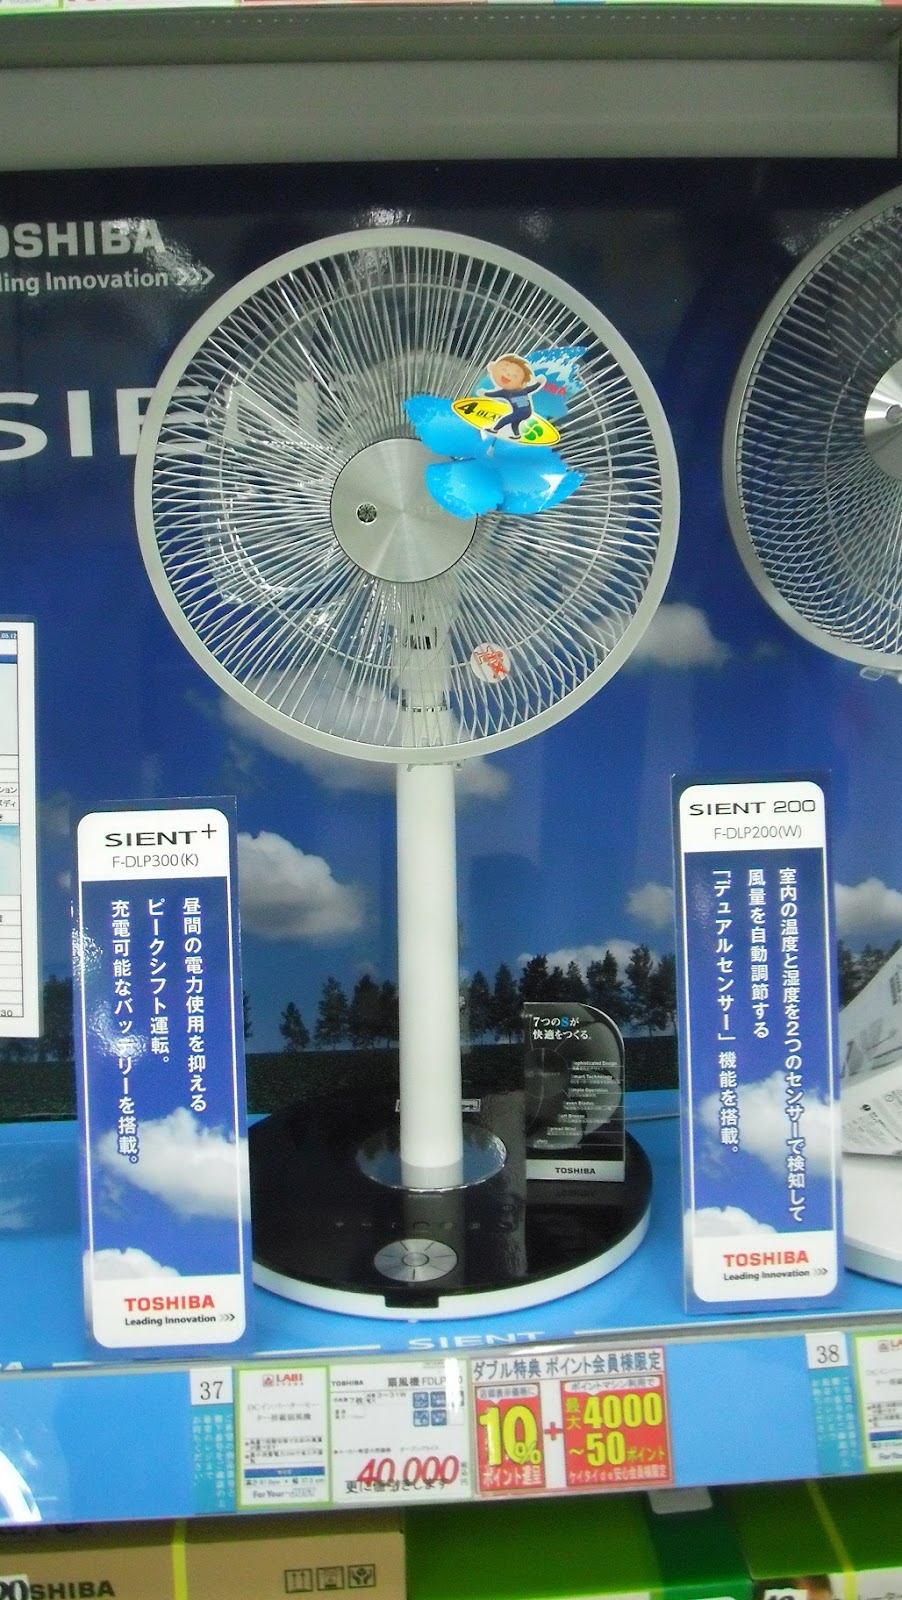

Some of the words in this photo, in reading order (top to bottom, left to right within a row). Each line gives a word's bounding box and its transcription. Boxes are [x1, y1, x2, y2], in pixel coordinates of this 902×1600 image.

[0, 218, 165, 260] SHIBA
[0, 274, 39, 297] ing
[46, 268, 169, 292] Innovation
[457, 401, 479, 415] 4
[689, 800, 767, 817] SIENT
[773, 799, 816, 814] 200
[714, 824, 803, 840] F-DLP200(W)
[112, 853, 200, 869] F-DLP300(K)
[748, 868, 771, 1040] 風量を自動調節する
[148, 897, 170, 1064] ピークシフト運転。
[182, 897, 207, 1113] 昼間の電力使用を抑える
[532, 1016, 580, 1028] 7つのSが
[779, 867, 807, 1223] 室内の温度と湿度を2つのセンサーで検知して
[554, 1166, 596, 1175] TOSHIBA
[724, 1250, 810, 1268] TOSHIBA
[724, 1272, 760, 1282] Leading
[761, 1270, 810, 1280] Innovation
[124, 1294, 216, 1313] TOSHIBA
[124, 1317, 163, 1327] Leading
[165, 1314, 217, 1325] Innovation
[408, 1331, 546, 1350] SIENT
[815, 1344, 841, 1364] 38
[473, 1360, 542, 1381] ダブル特典
[546, 1350, 663, 1377] ポイント会員様限定
[199, 1380, 224, 1401] 37
[331, 1379, 364, 1387] TOSHIBA
[582, 1391, 663, 1429] 4000
[356, 1454, 460, 1487] 40000
[483, 1464, 544, 1488] ポイント進呈
[30, 1578, 117, 1600] SHIBA
